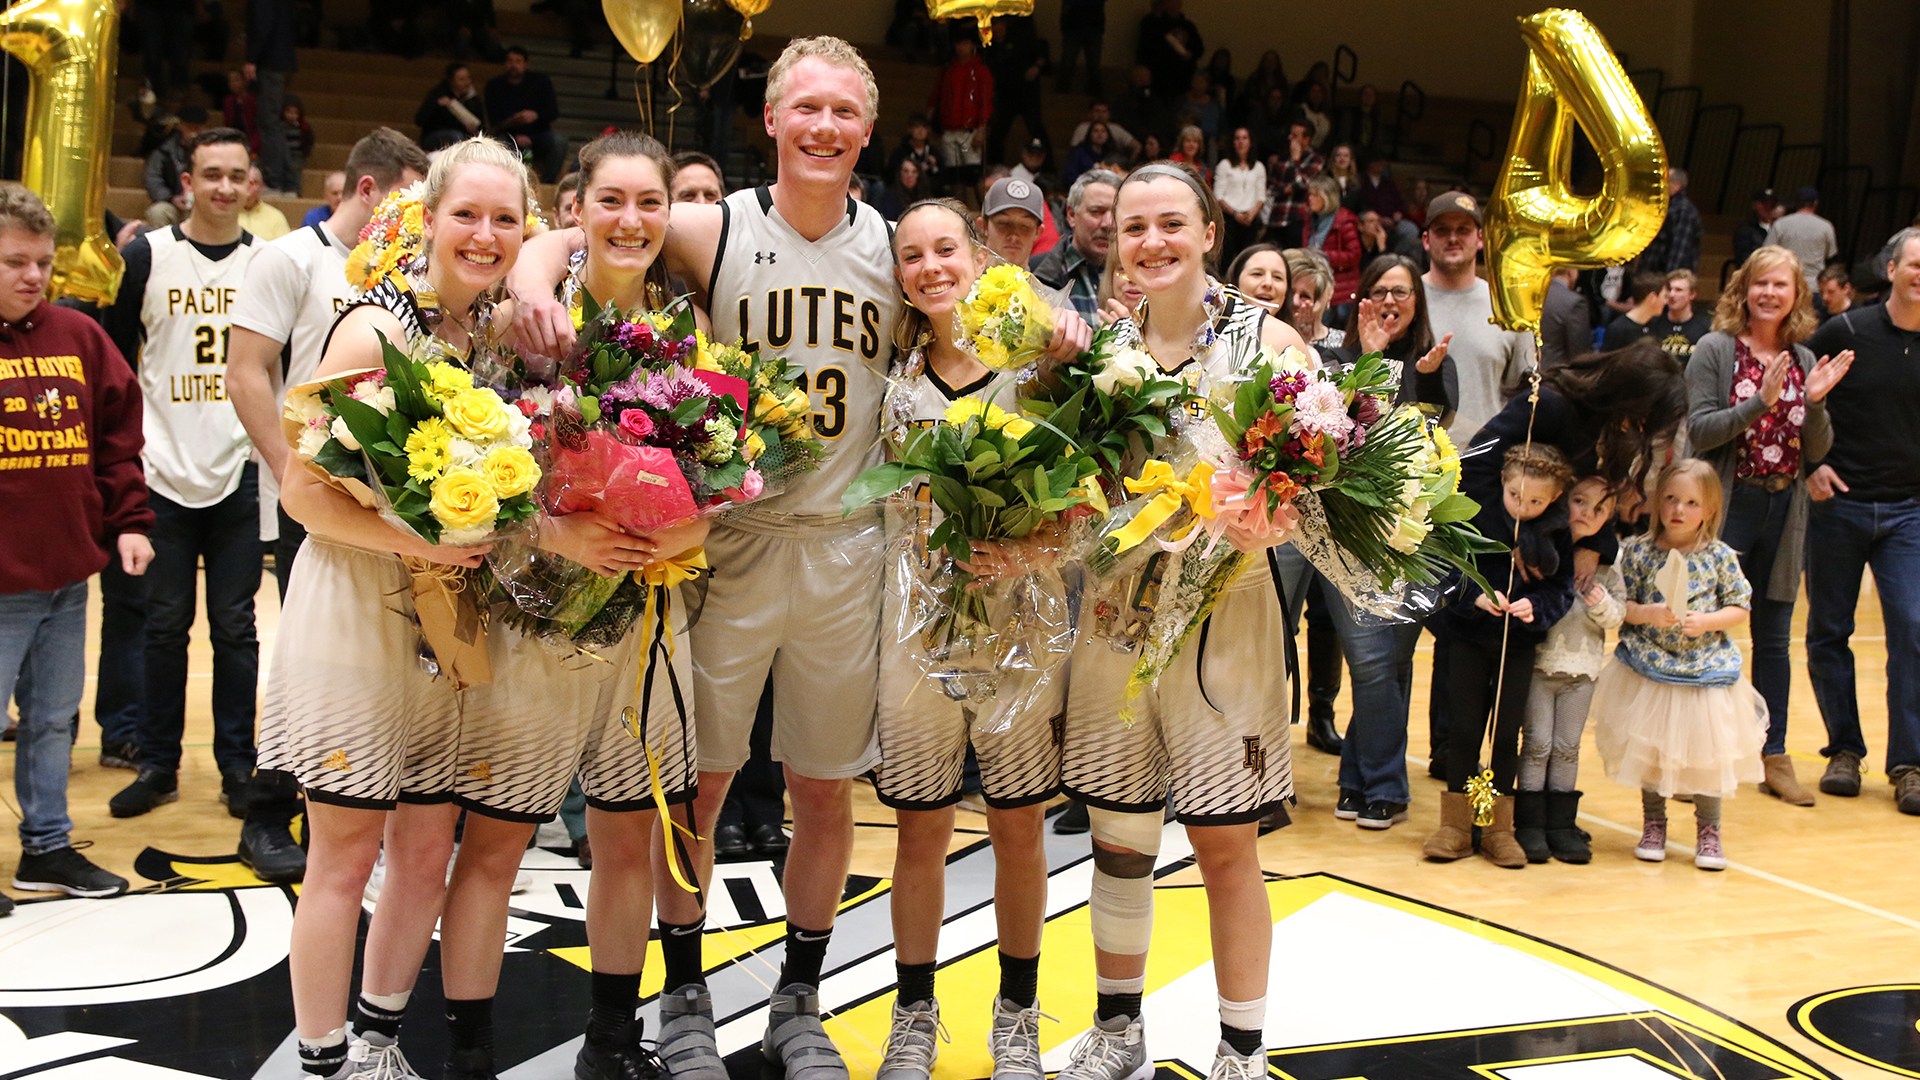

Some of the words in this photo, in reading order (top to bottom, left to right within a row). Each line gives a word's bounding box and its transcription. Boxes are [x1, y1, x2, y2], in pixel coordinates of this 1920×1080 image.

[168, 287, 237, 316] PACIF
[738, 285, 881, 361] LUTES
[194, 323, 232, 366] 21
[0, 357, 38, 381] HITE
[170, 374, 229, 403] LUTHE
[787, 363, 848, 441] 3
[4, 396, 27, 413] 20
[46, 454, 70, 468] THE
